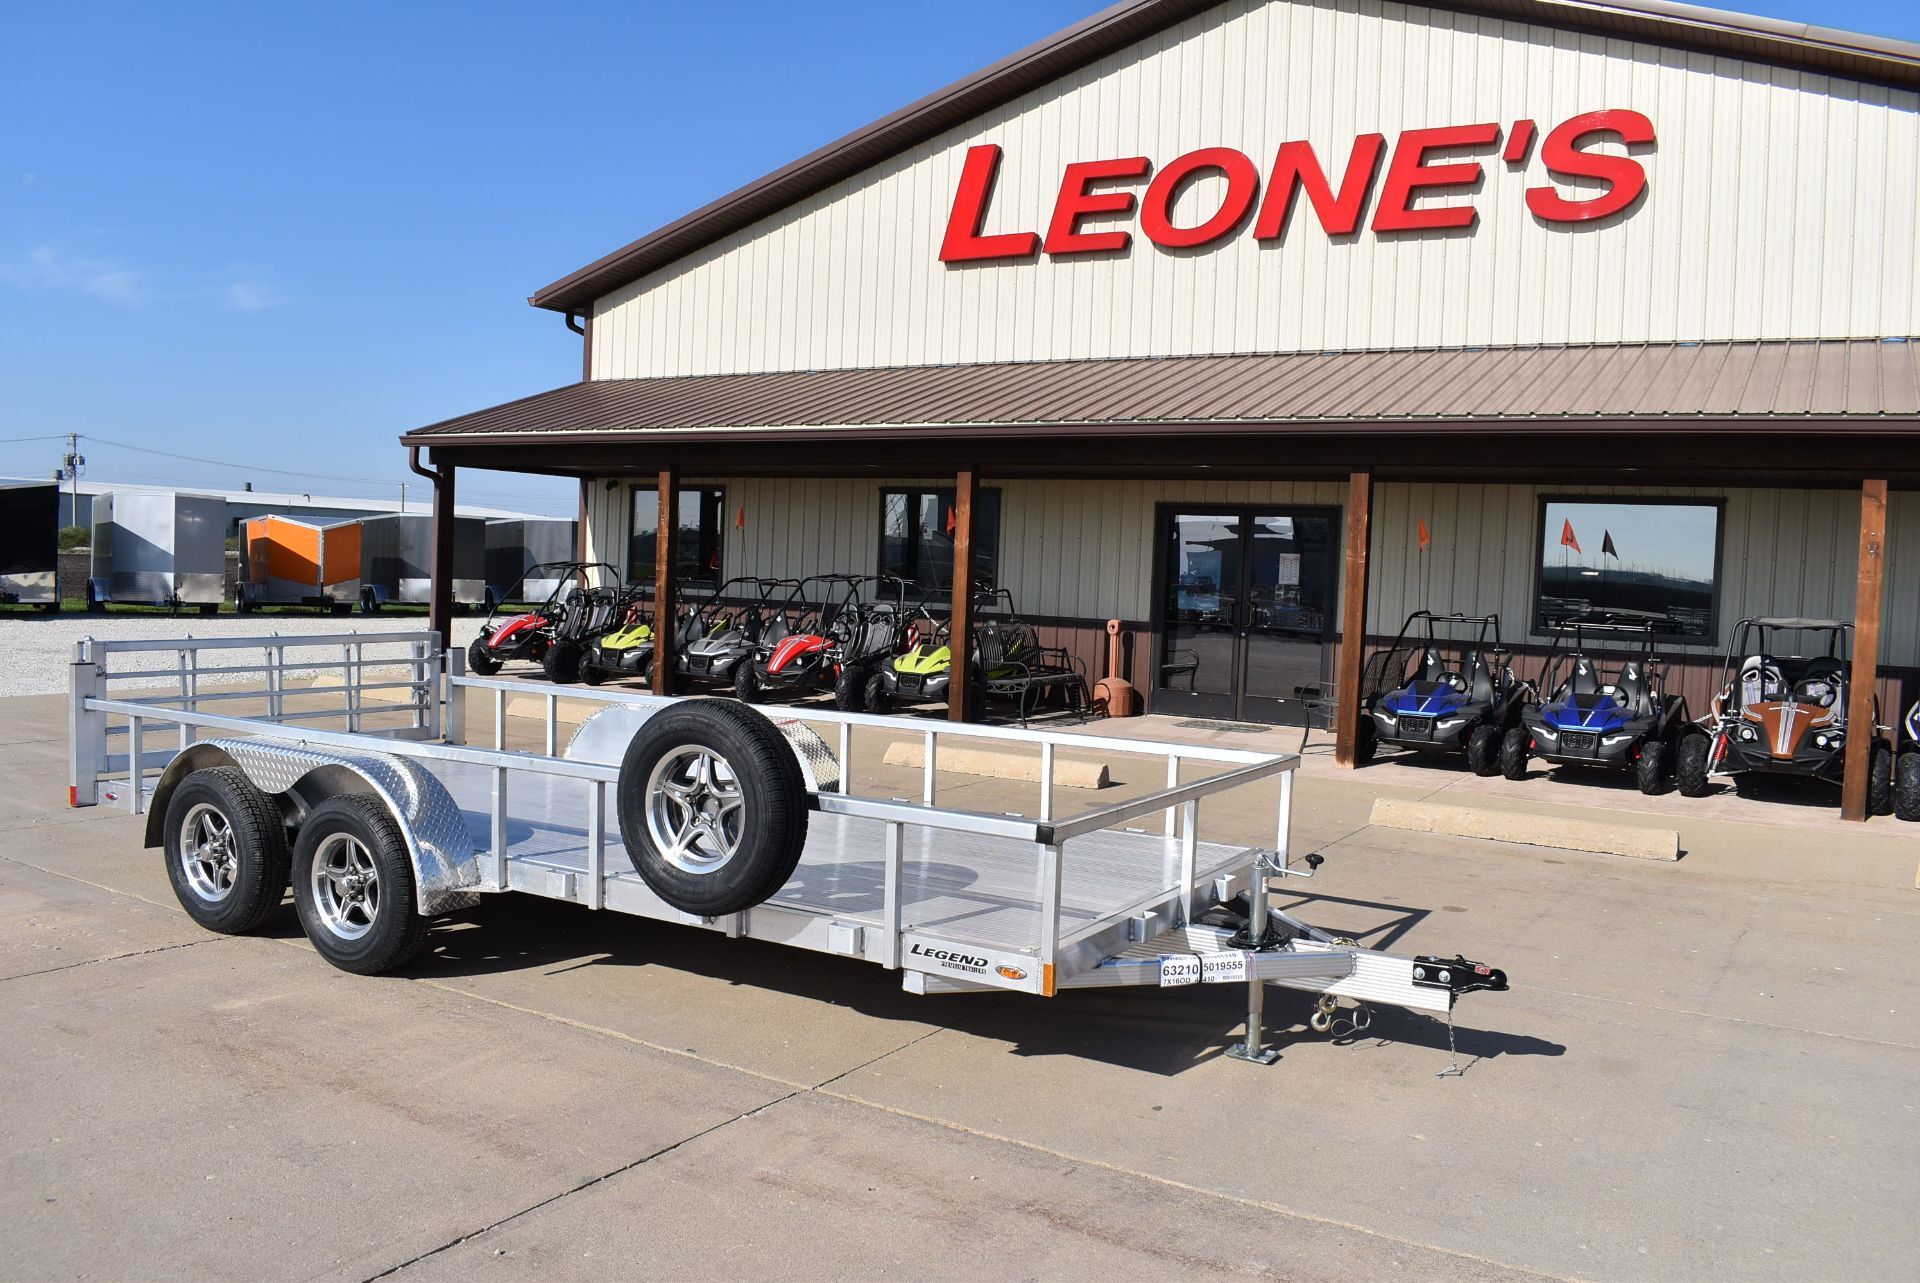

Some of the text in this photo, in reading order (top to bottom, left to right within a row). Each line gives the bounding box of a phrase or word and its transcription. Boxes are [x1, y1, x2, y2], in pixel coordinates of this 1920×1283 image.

[938, 108, 1656, 262] LEONE'S
[910, 943, 988, 968] LEGEND
[1163, 961, 1243, 977] 63210 5019555
